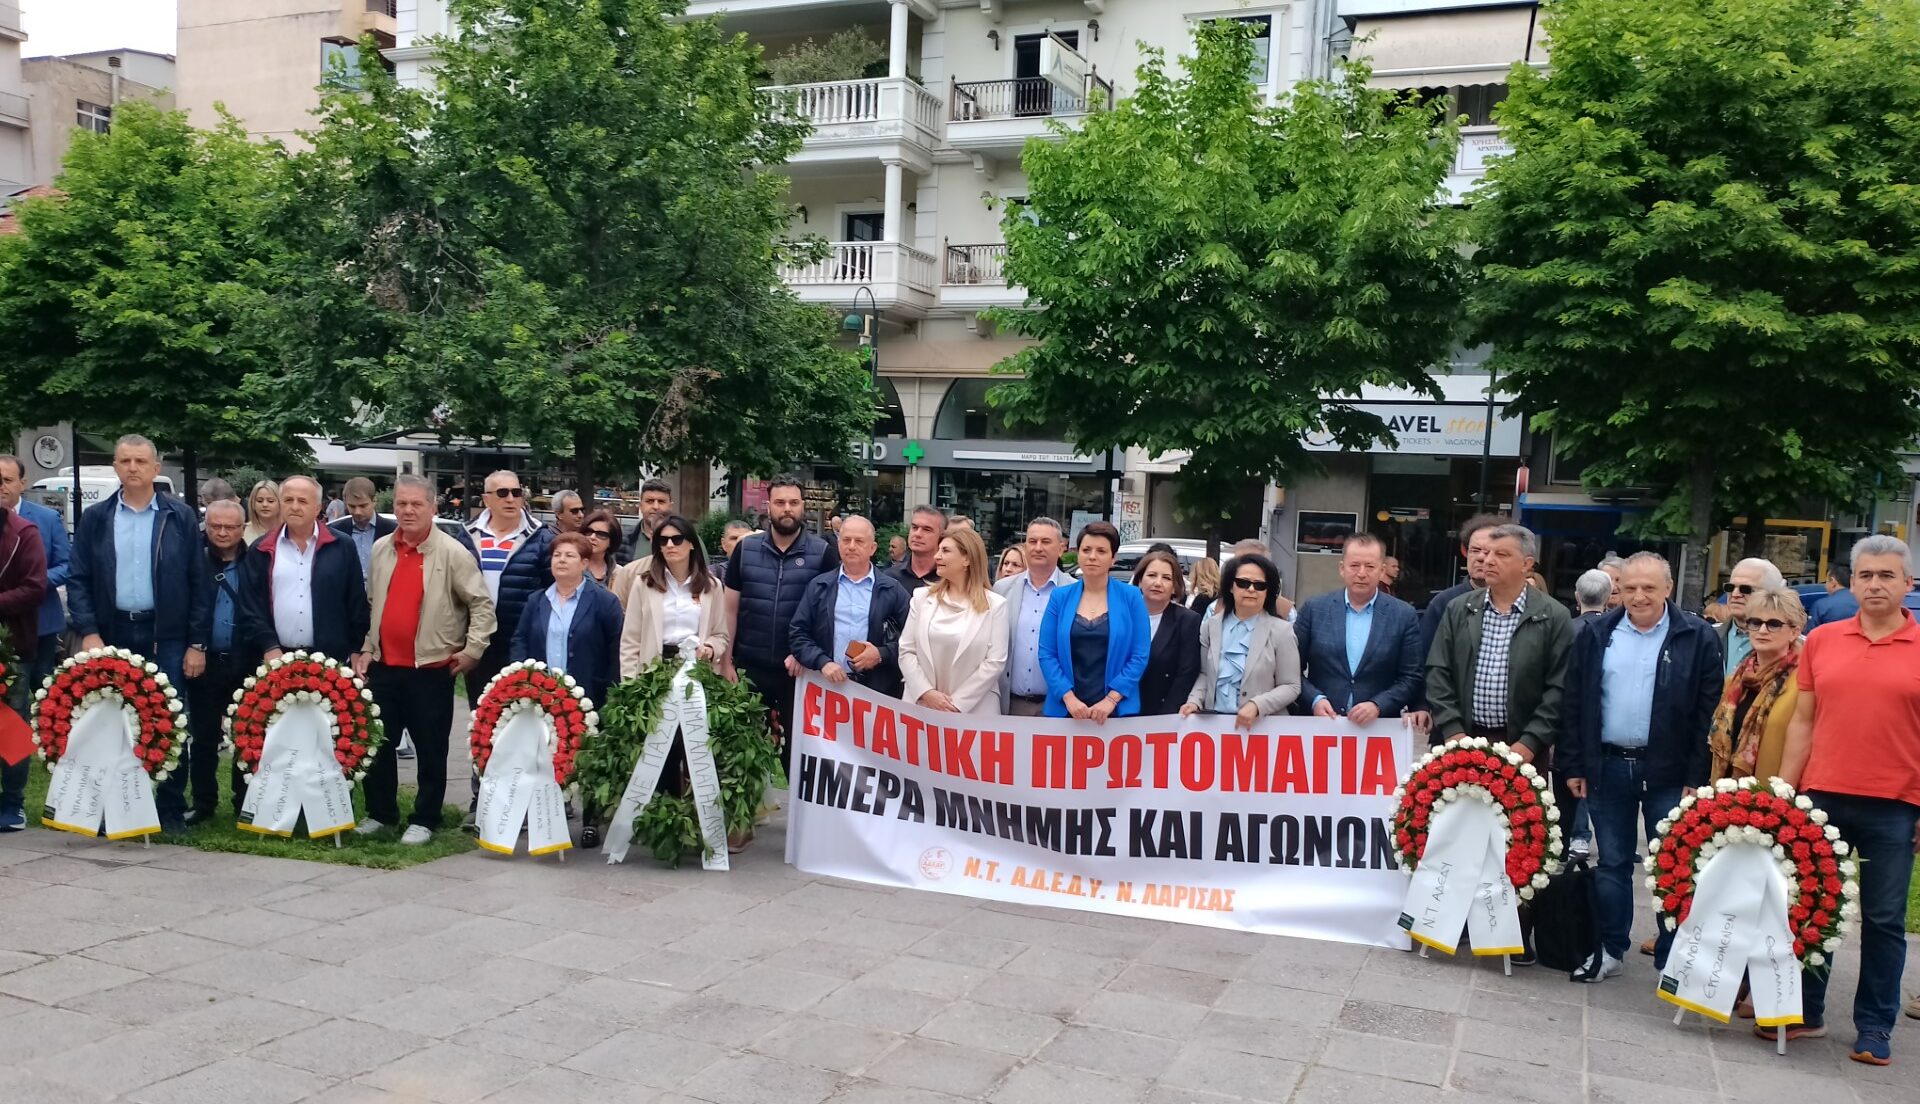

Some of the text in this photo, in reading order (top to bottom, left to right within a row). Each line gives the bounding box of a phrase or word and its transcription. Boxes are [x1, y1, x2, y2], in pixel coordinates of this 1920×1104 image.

[1388, 415, 1442, 433] AVEL
[1402, 437, 1432, 446] TICKETS
[680, 676, 704, 736] ΙΝΗΜΑ
[803, 682, 1398, 797] ΕΡΓΑΤΙΚΗ ΠΡΩΤΟΜΑΓΙΑ
[798, 753, 1403, 871] ΗΜΕΡΑ ΜΝΗΜΗΣ ΚΑΙ ΑΓΩΝΩΝ
[963, 856, 1002, 884] Ν.Τ.
[1116, 881, 1138, 903] Ν.
[1141, 883, 1236, 913] ΛΑΡΙΣΑΣ
